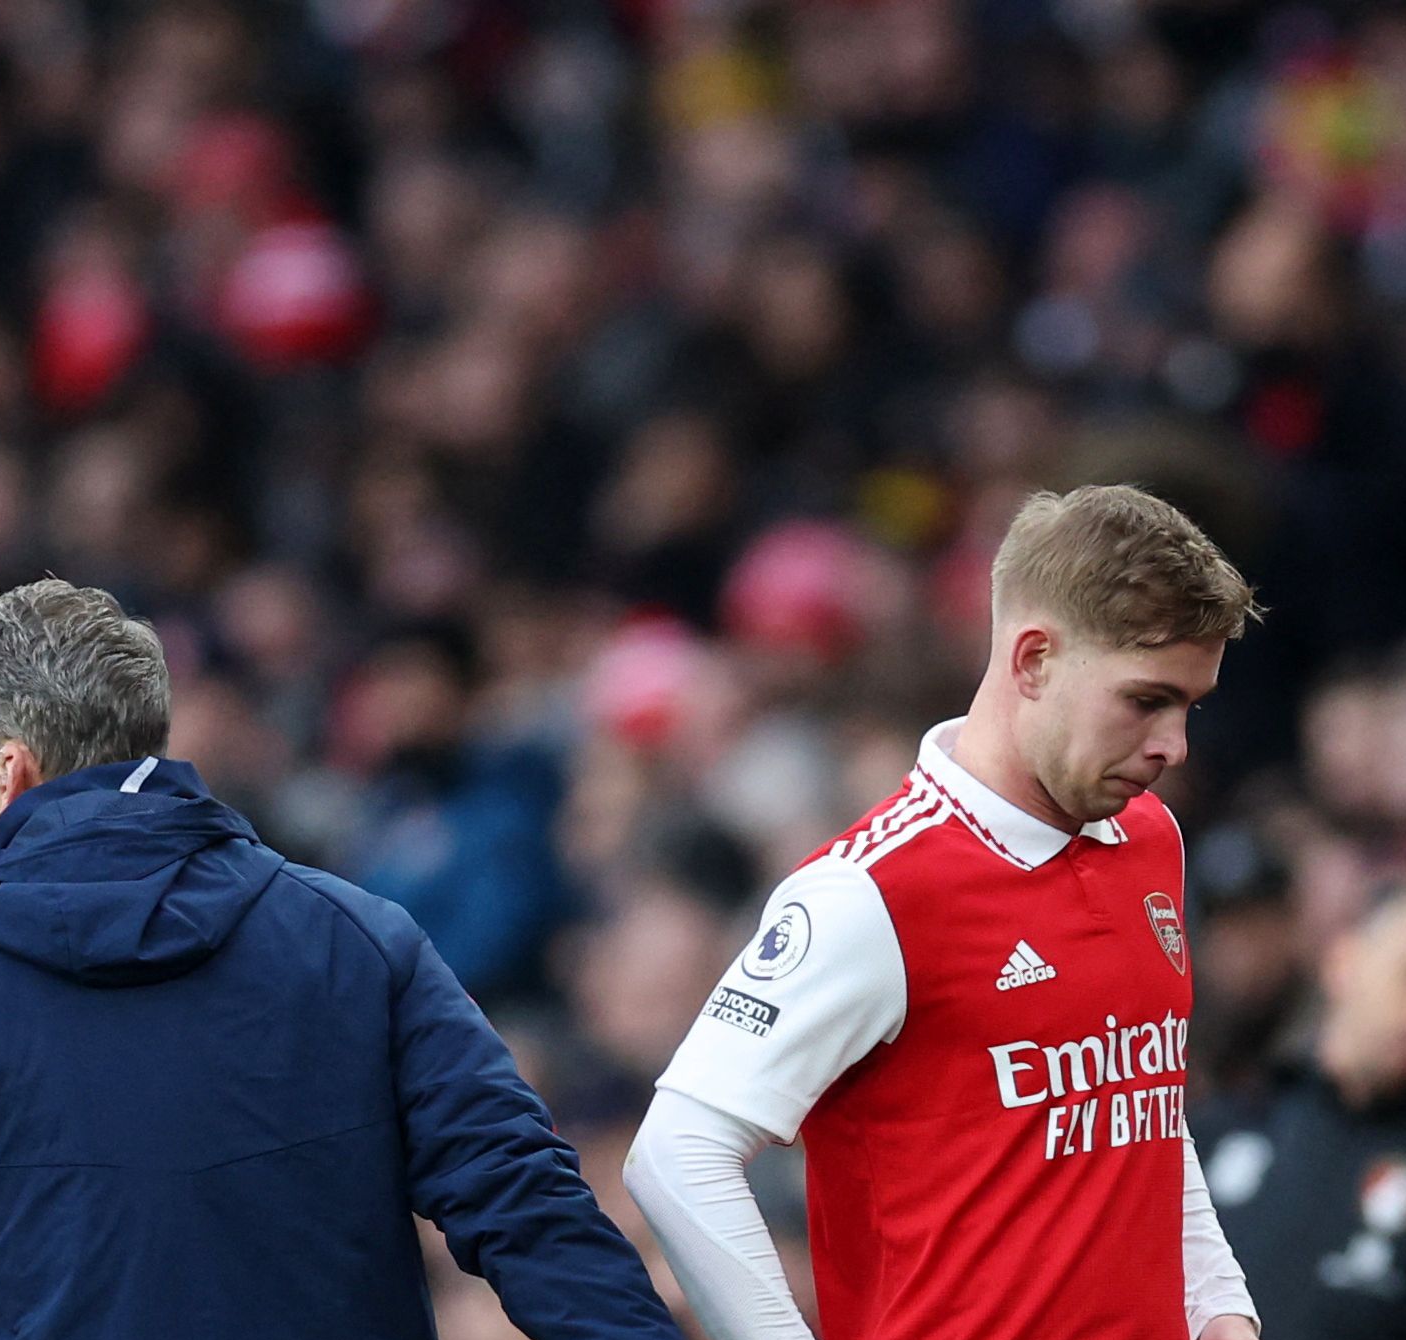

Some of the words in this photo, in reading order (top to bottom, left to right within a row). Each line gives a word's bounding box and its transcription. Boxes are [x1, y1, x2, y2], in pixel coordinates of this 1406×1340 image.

[996, 964, 1057, 991] adidas
[718, 1006, 772, 1037] racism
[725, 991, 771, 1022] room
[987, 1008, 1188, 1109] Emirate
[1045, 1098, 1098, 1160] FLY
